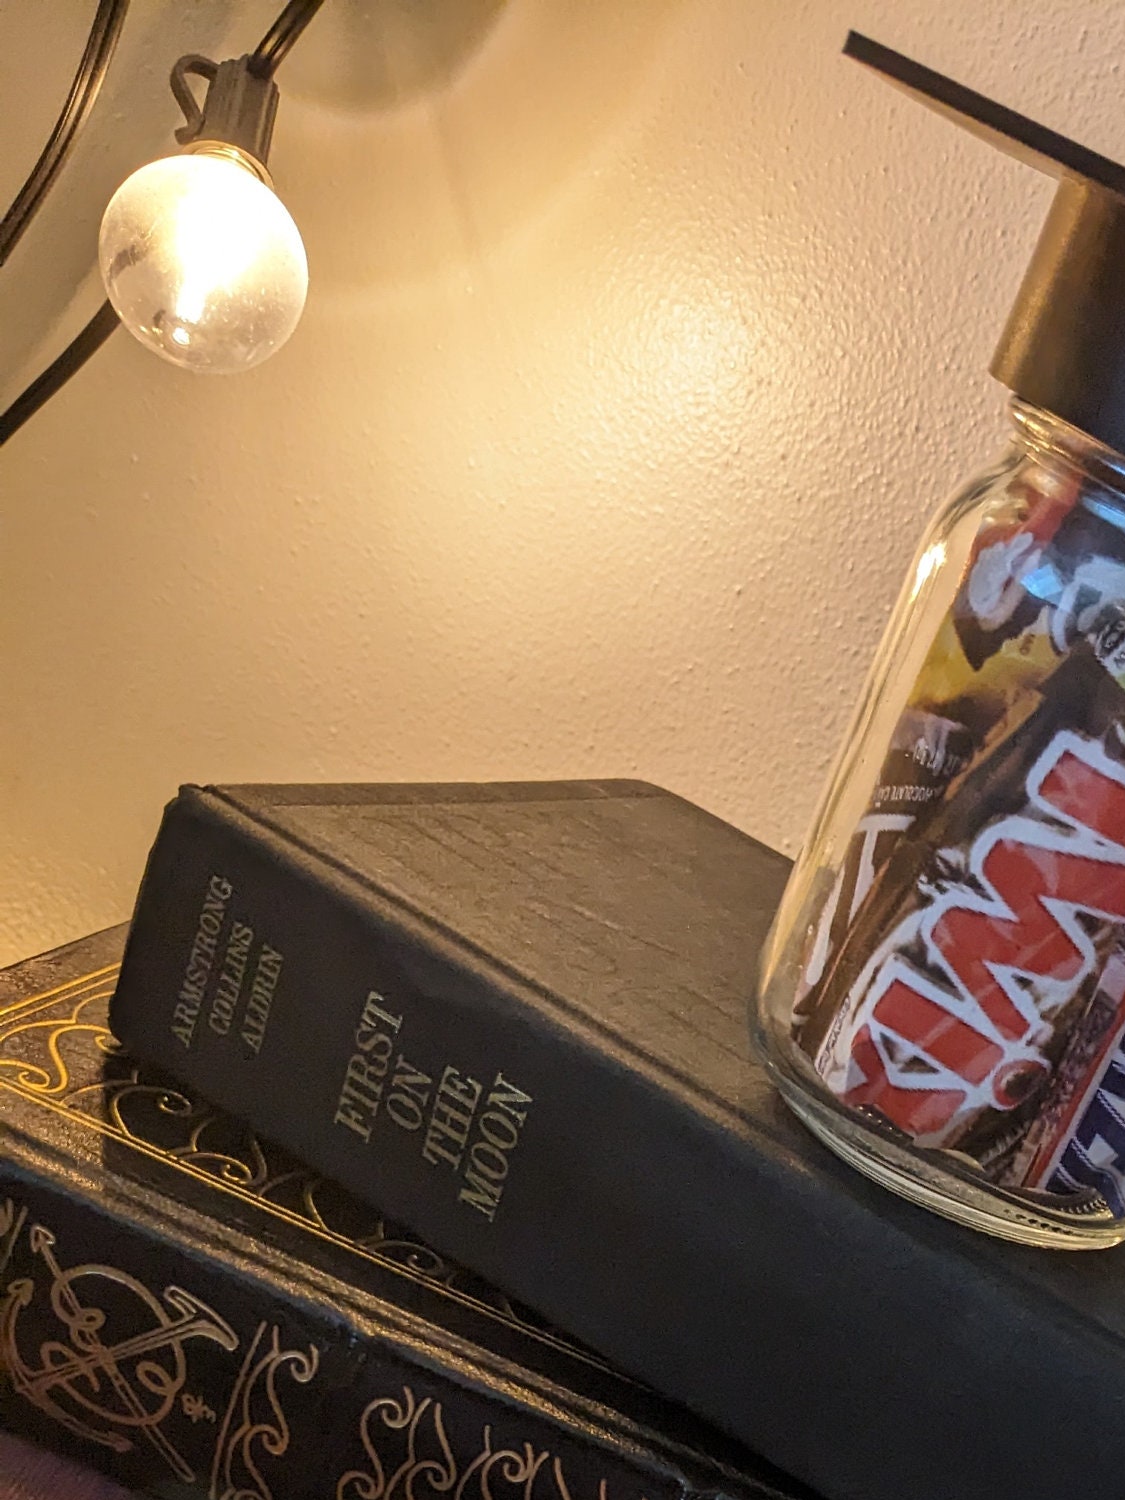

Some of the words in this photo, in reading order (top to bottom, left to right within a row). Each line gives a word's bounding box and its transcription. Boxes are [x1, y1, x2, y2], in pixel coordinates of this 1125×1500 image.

[170, 874, 233, 1048] ARMSTRONG
[208, 921, 254, 1036] COLLINS
[241, 943, 284, 1054] ALDRIN
[333, 990, 403, 1144] FIRST
[385, 1055, 433, 1132] ON
[421, 1064, 484, 1171] THE
[457, 1072, 534, 1223] MOON
